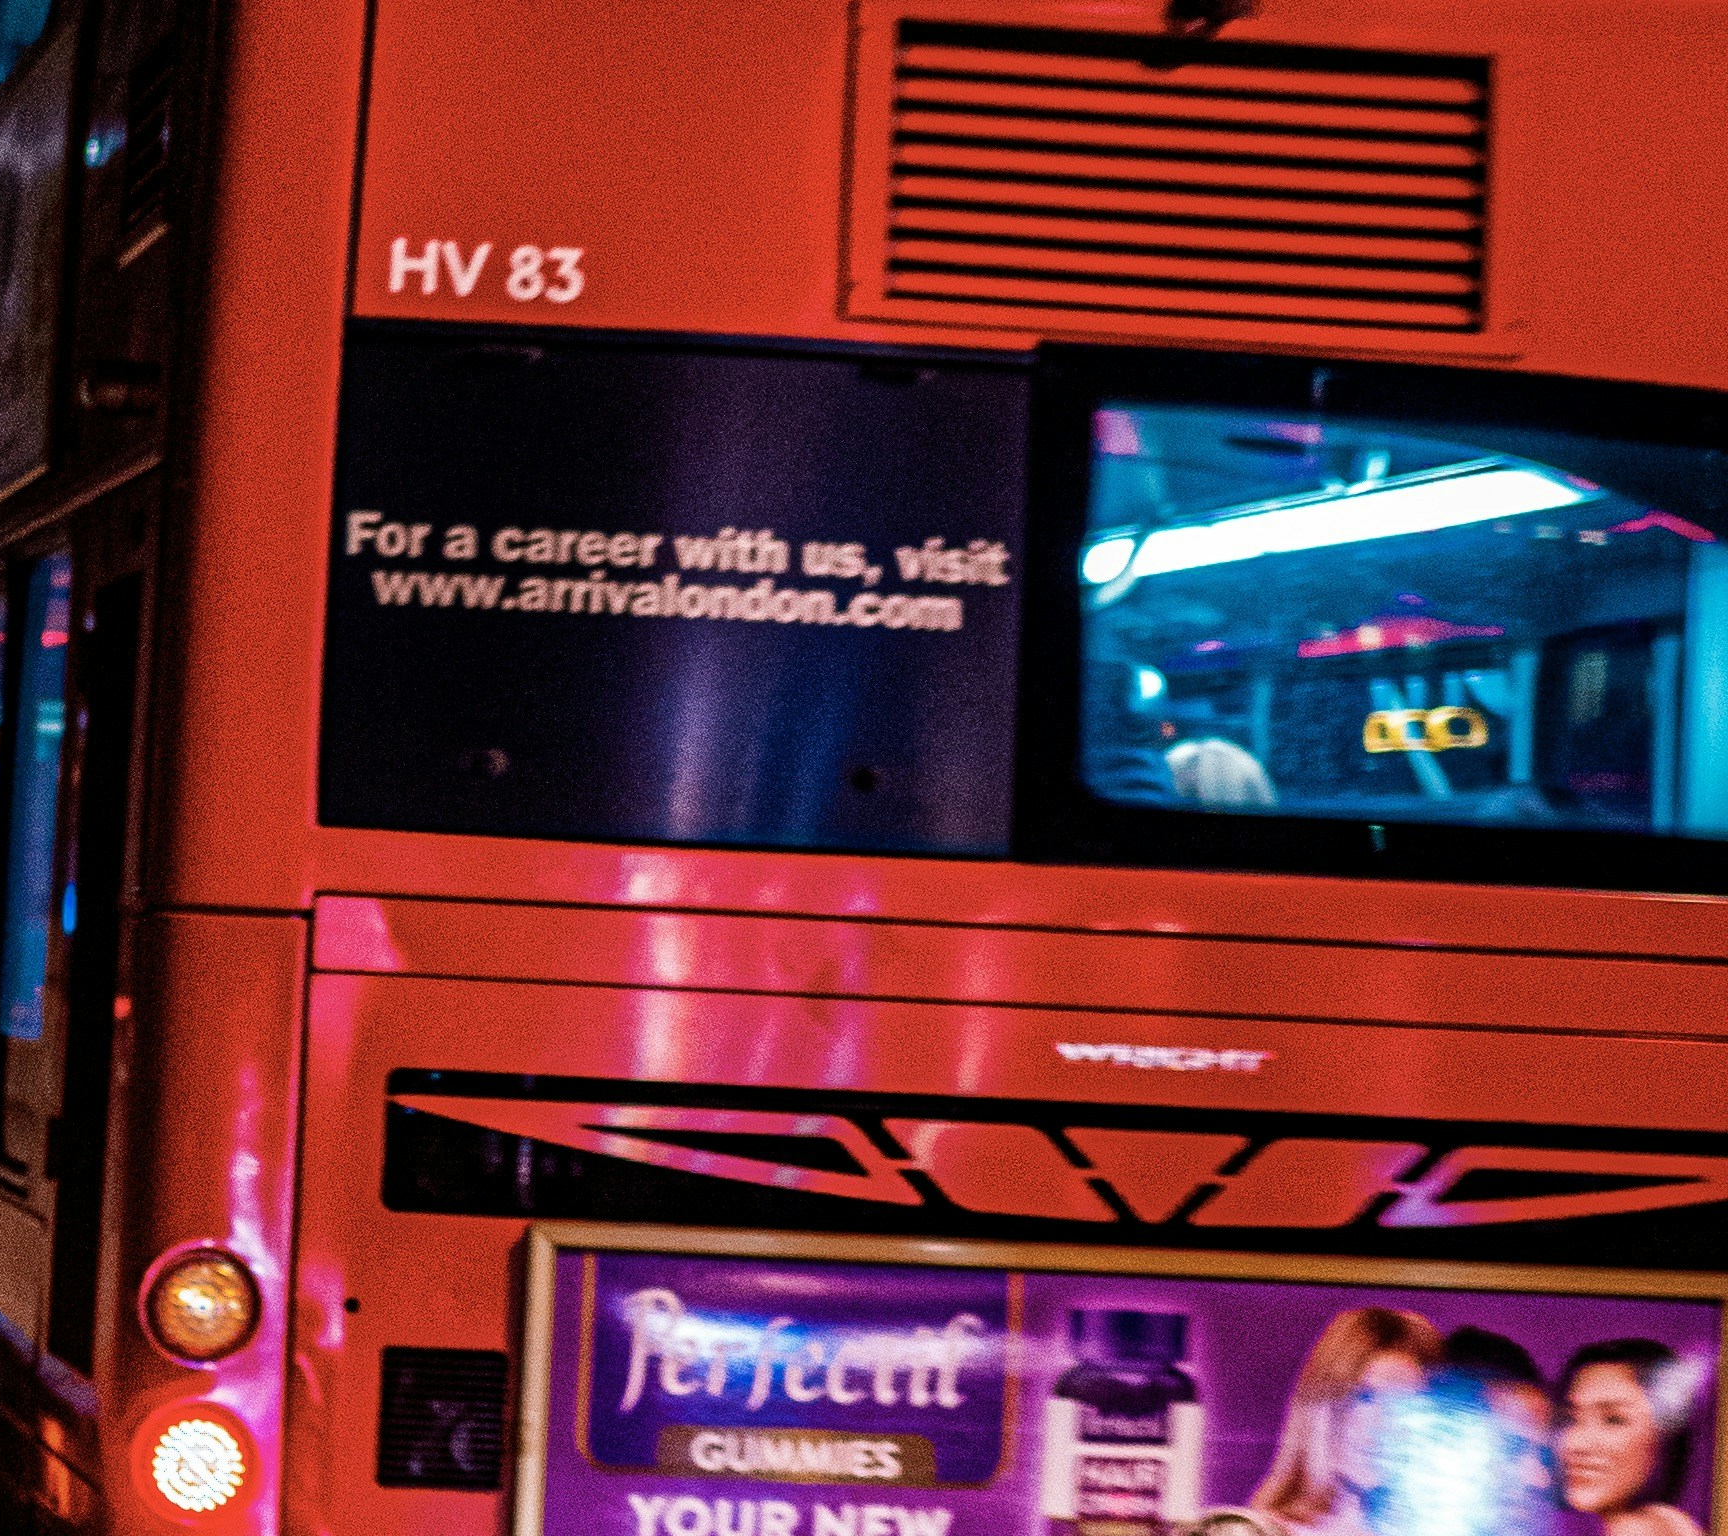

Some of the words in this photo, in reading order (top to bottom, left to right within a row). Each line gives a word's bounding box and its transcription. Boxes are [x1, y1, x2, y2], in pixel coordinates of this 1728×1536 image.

[388, 237, 492, 298] HV
[507, 245, 586, 304] 83
[345, 509, 434, 558] For
[442, 525, 478, 561] a
[490, 527, 664, 570] career
[673, 527, 790, 576] with
[801, 541, 882, 586] us,
[896, 539, 1012, 587] visit
[371, 568, 966, 633] www.arrivalondon.com
[689, 1430, 905, 1480] GUMMIES
